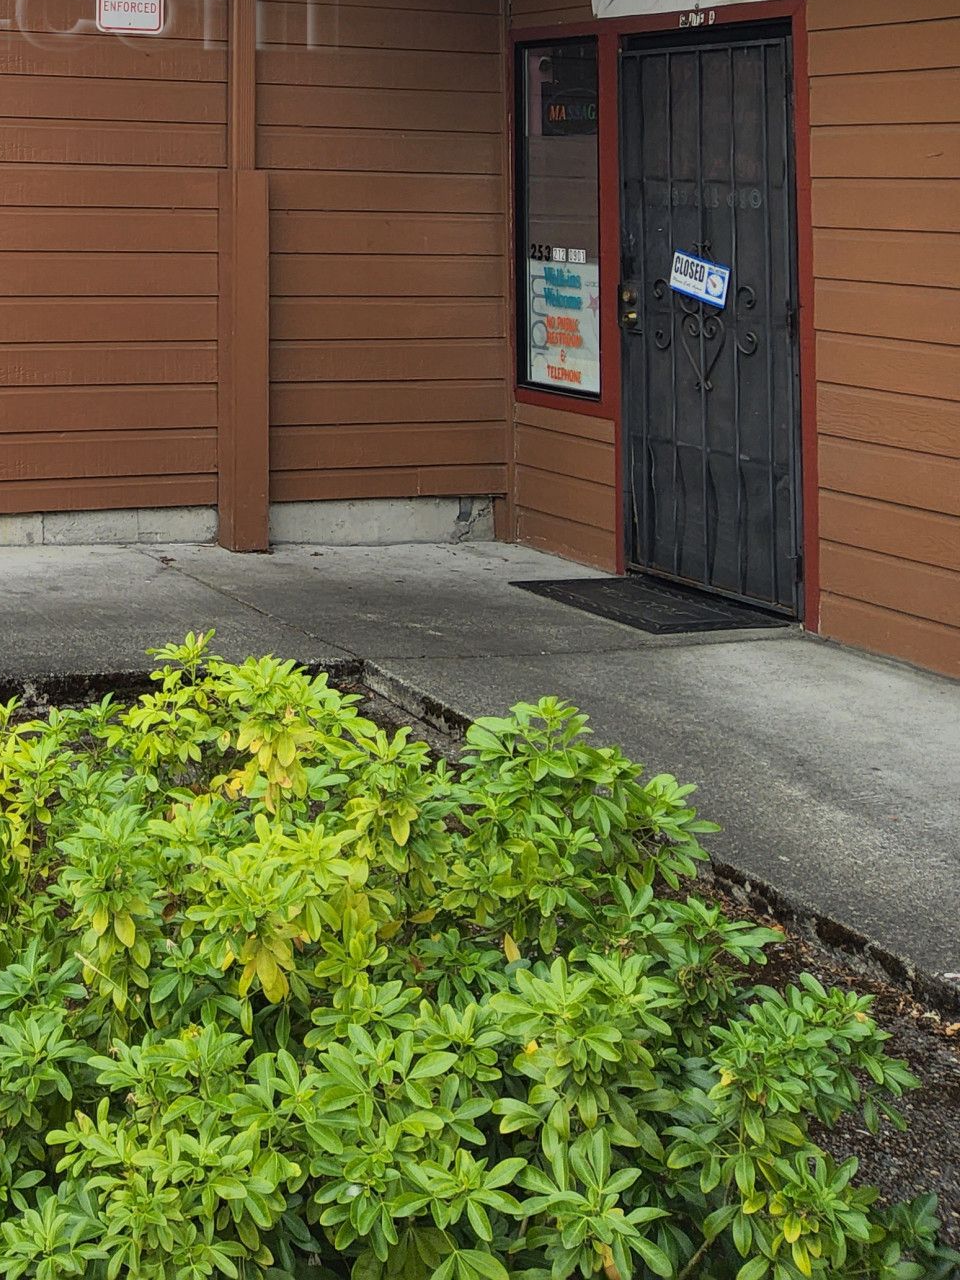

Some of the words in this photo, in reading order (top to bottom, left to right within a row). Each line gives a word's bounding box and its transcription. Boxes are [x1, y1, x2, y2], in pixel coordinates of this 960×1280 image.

[104, 0, 157, 14] ENFORCED
[530, 243, 551, 262] 253
[674, 256, 706, 284] CLOSED
[546, 365, 583, 385] TELEPHONE
